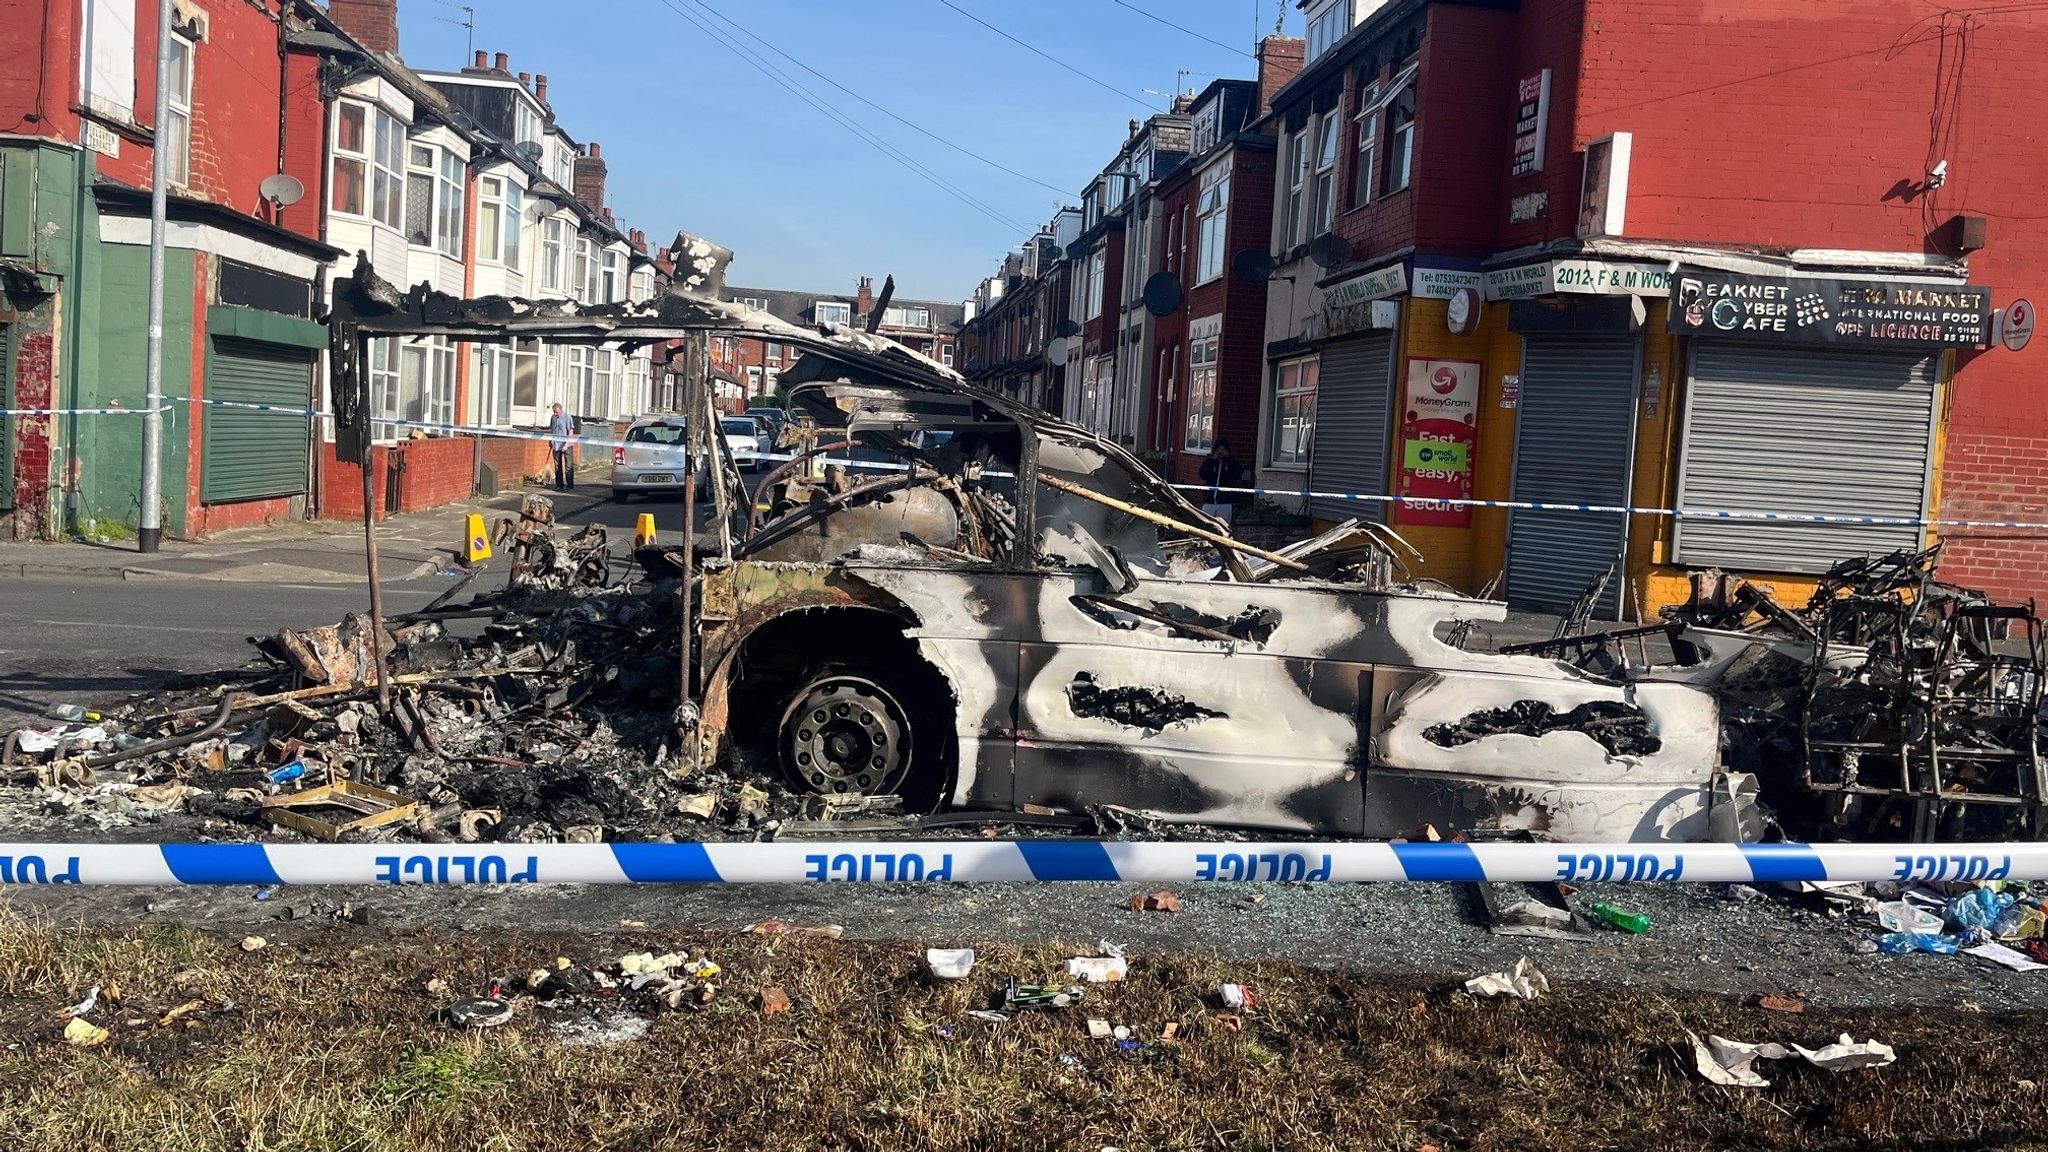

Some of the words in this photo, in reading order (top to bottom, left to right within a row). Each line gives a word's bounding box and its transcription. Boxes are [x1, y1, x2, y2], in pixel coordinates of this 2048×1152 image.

[1420, 273, 1433, 282] Tel:
[1522, 266, 1546, 279] WORLD
[1598, 269, 1607, 286] F
[1610, 270, 1620, 287] &
[1625, 271, 1637, 288] M
[1640, 272, 1672, 290] WOR
[1498, 282, 1543, 298] SUPERMARKET
[1894, 289, 1982, 310] MARKET
[1942, 312, 1980, 324] FOOD
[1415, 396, 1471, 408] MoneyGram
[375, 855, 538, 884] POLICE
[806, 853, 953, 882] POLICE
[1195, 853, 1332, 882] POLICE
[1552, 853, 1684, 881] POLICE
[1890, 854, 2011, 881] POLICE
